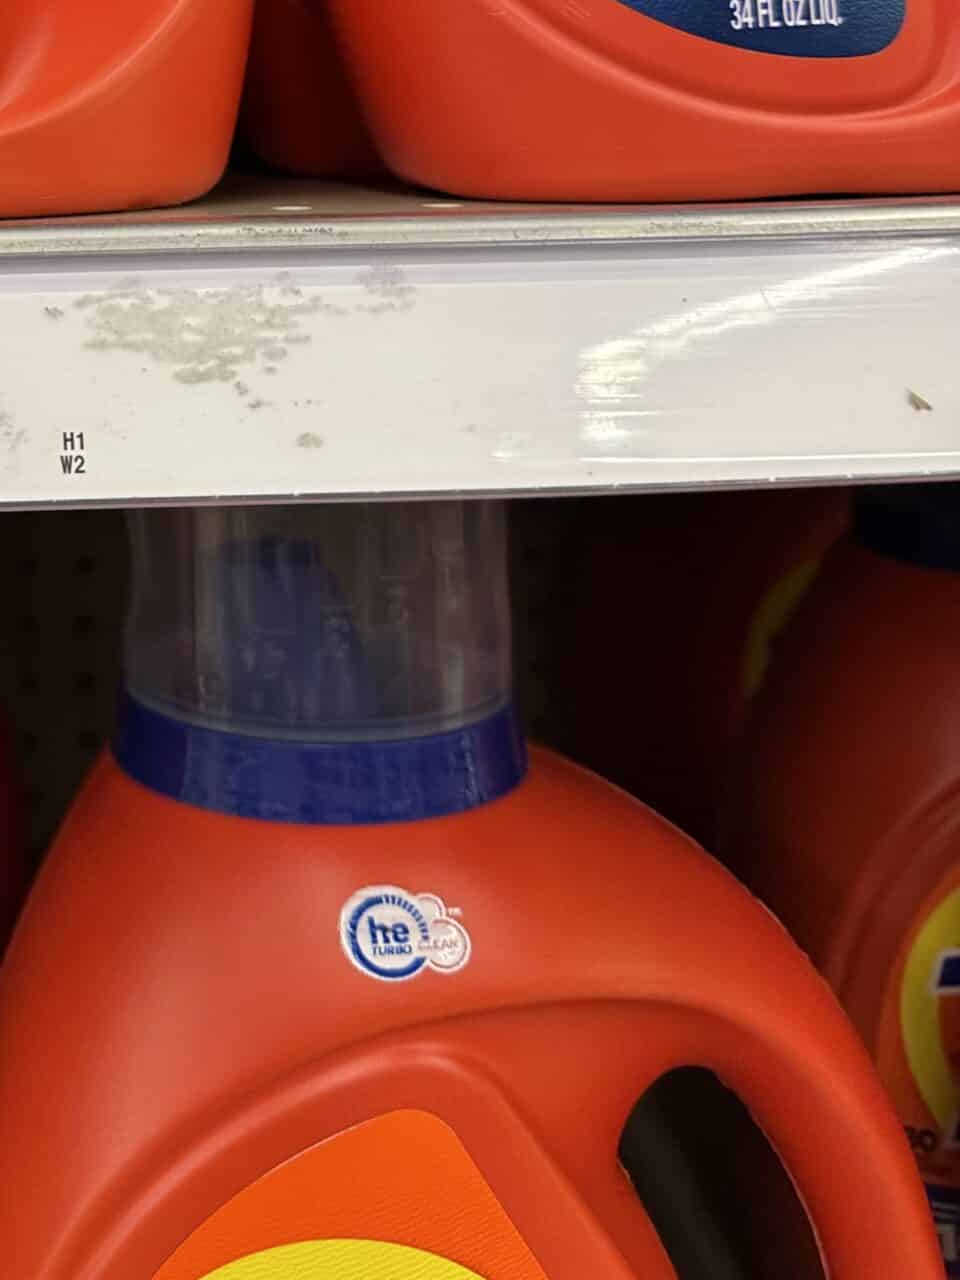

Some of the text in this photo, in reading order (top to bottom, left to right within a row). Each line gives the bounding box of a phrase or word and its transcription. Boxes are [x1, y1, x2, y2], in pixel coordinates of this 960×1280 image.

[626, 236, 669, 258] he
[63, 432, 84, 450] H1
[60, 455, 86, 474] W2
[368, 916, 409, 944] he
[371, 945, 412, 956] TURBO
